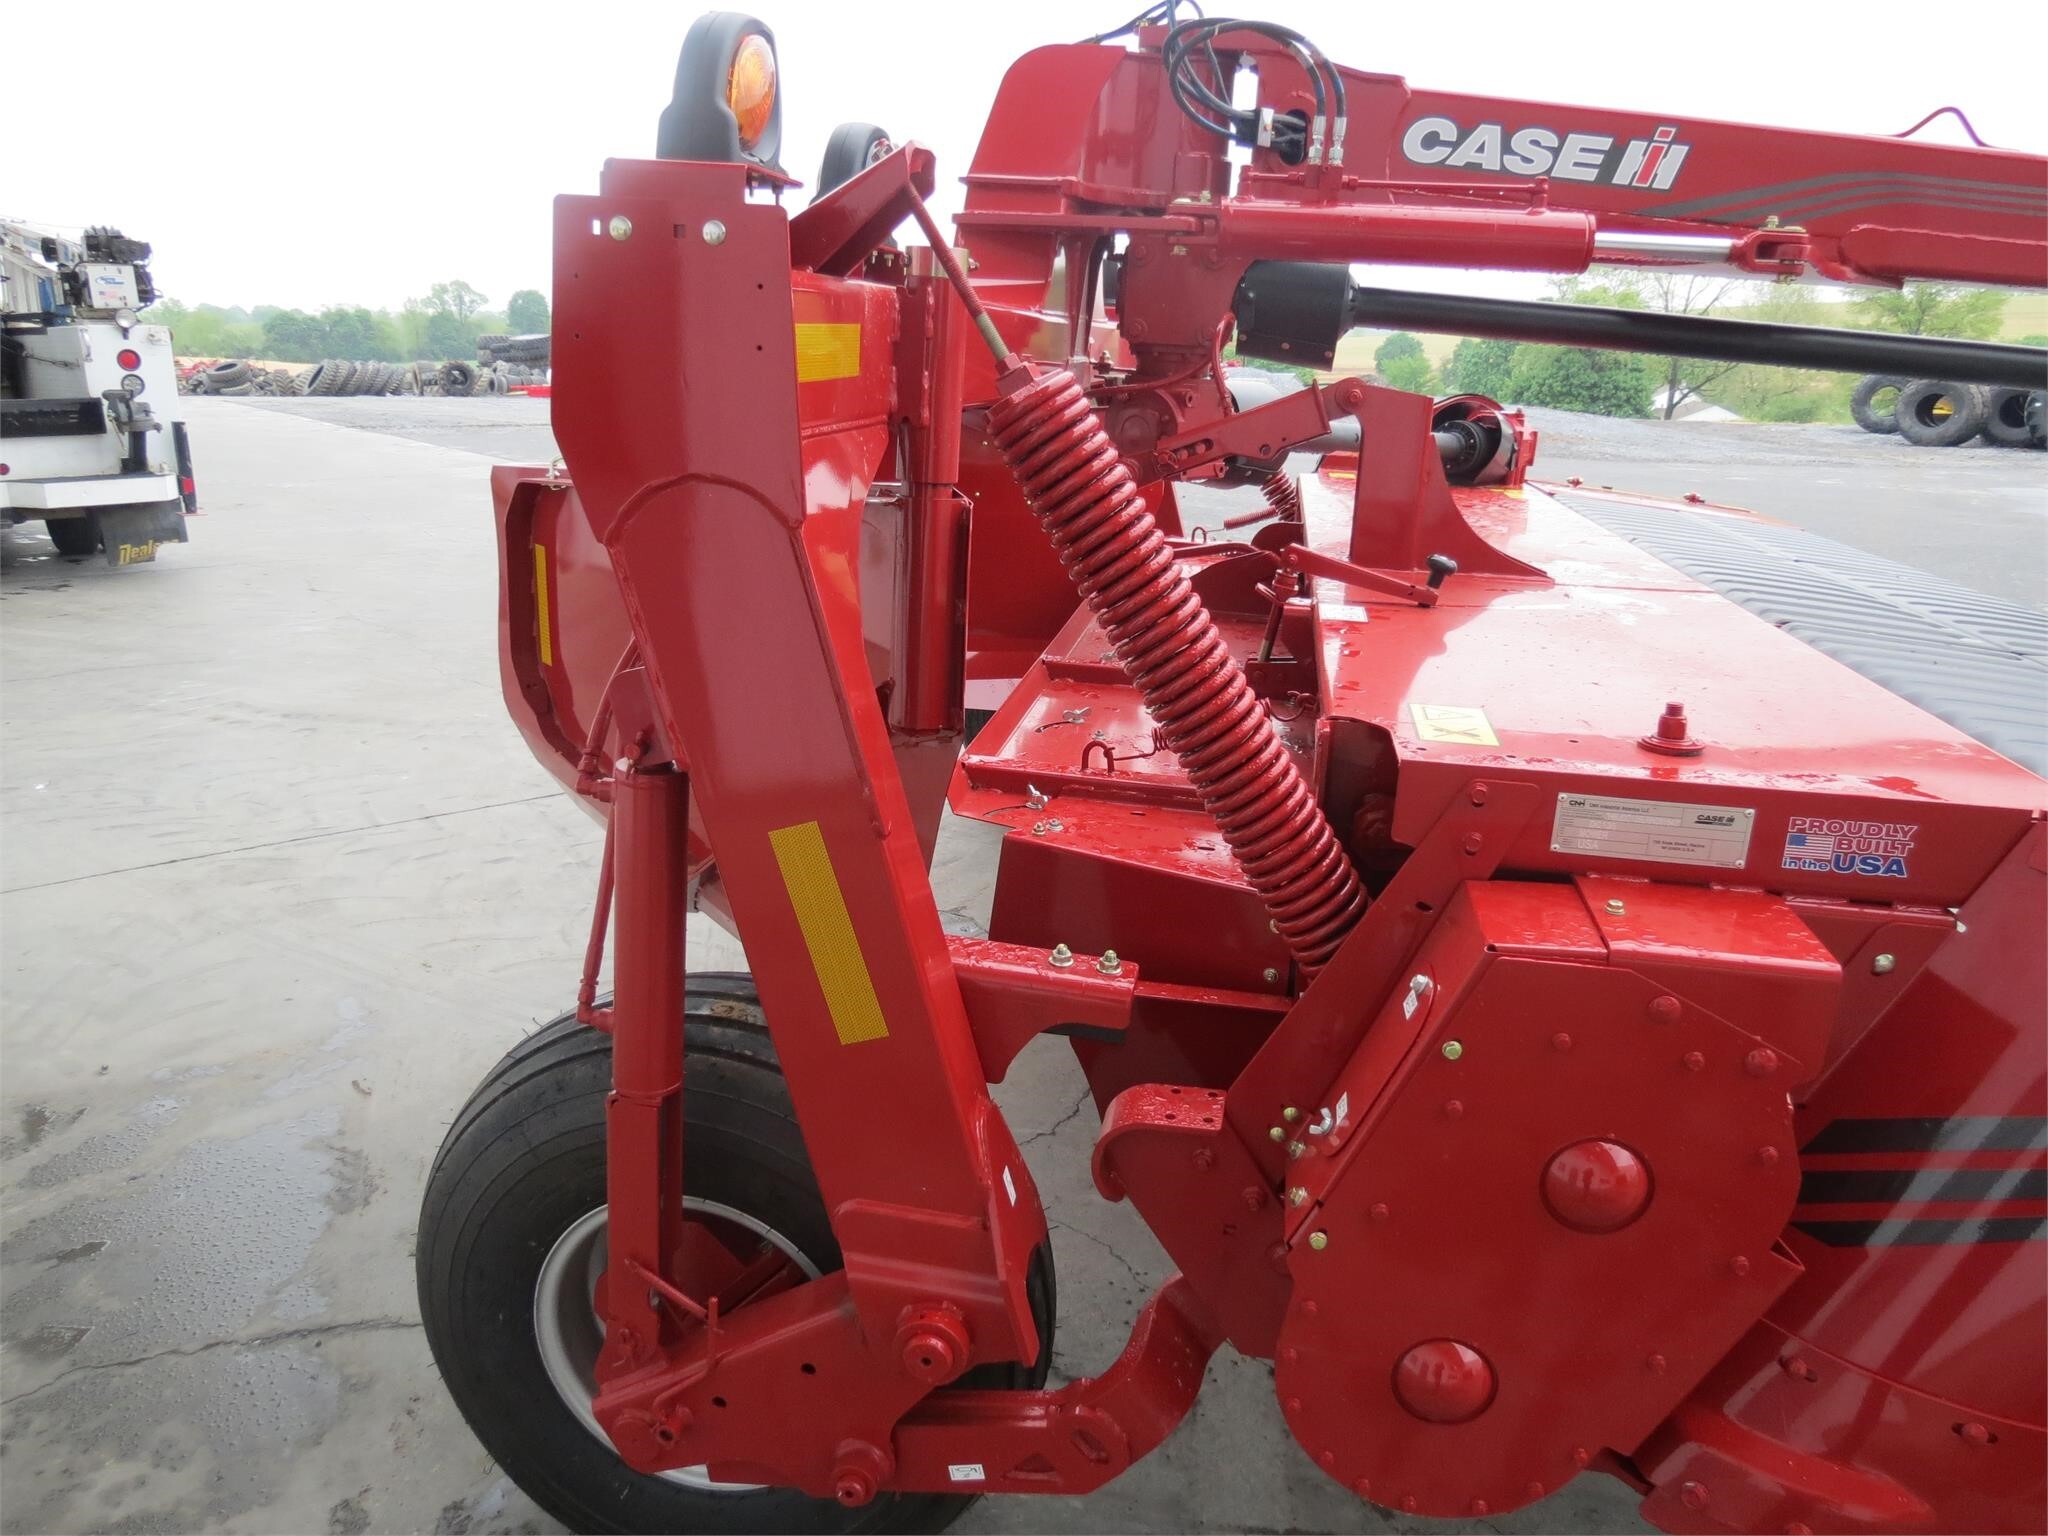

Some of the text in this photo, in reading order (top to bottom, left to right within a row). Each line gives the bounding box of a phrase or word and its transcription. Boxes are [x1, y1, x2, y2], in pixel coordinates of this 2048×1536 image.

[1402, 117, 1614, 182] CASE
[1569, 799, 1586, 807] CNH
[1697, 814, 1726, 822] CASE
[1788, 816, 1918, 840] PROUDLY
[1834, 836, 1914, 857] BUILT
[1782, 853, 1908, 878] in the USA
